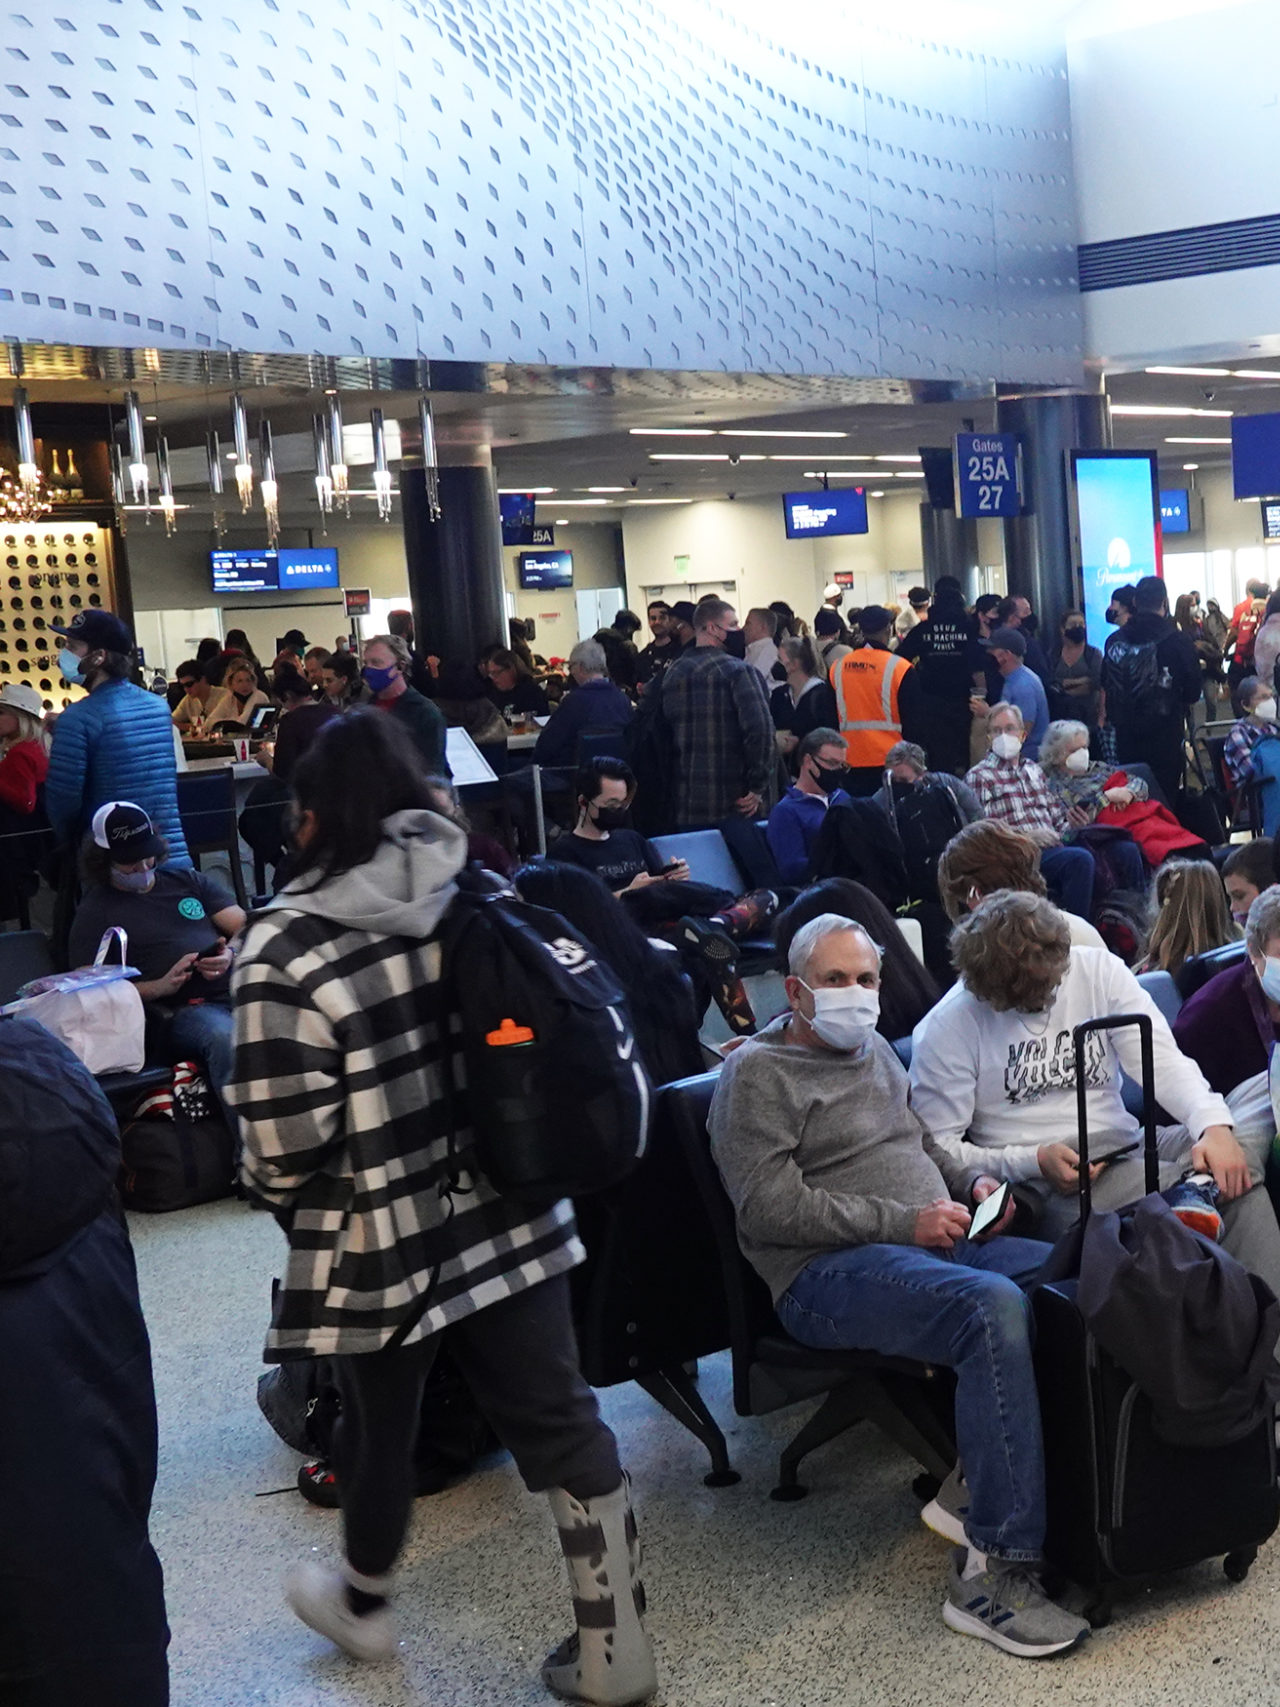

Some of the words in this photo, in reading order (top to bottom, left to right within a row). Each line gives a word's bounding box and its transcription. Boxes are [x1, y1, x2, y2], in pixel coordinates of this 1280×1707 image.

[972, 438, 1003, 453] Gates
[968, 455, 1010, 481] 25A
[978, 484, 1003, 510] 27
[295, 564, 324, 574] DELTA
[934, 632, 968, 642] MACHINA
